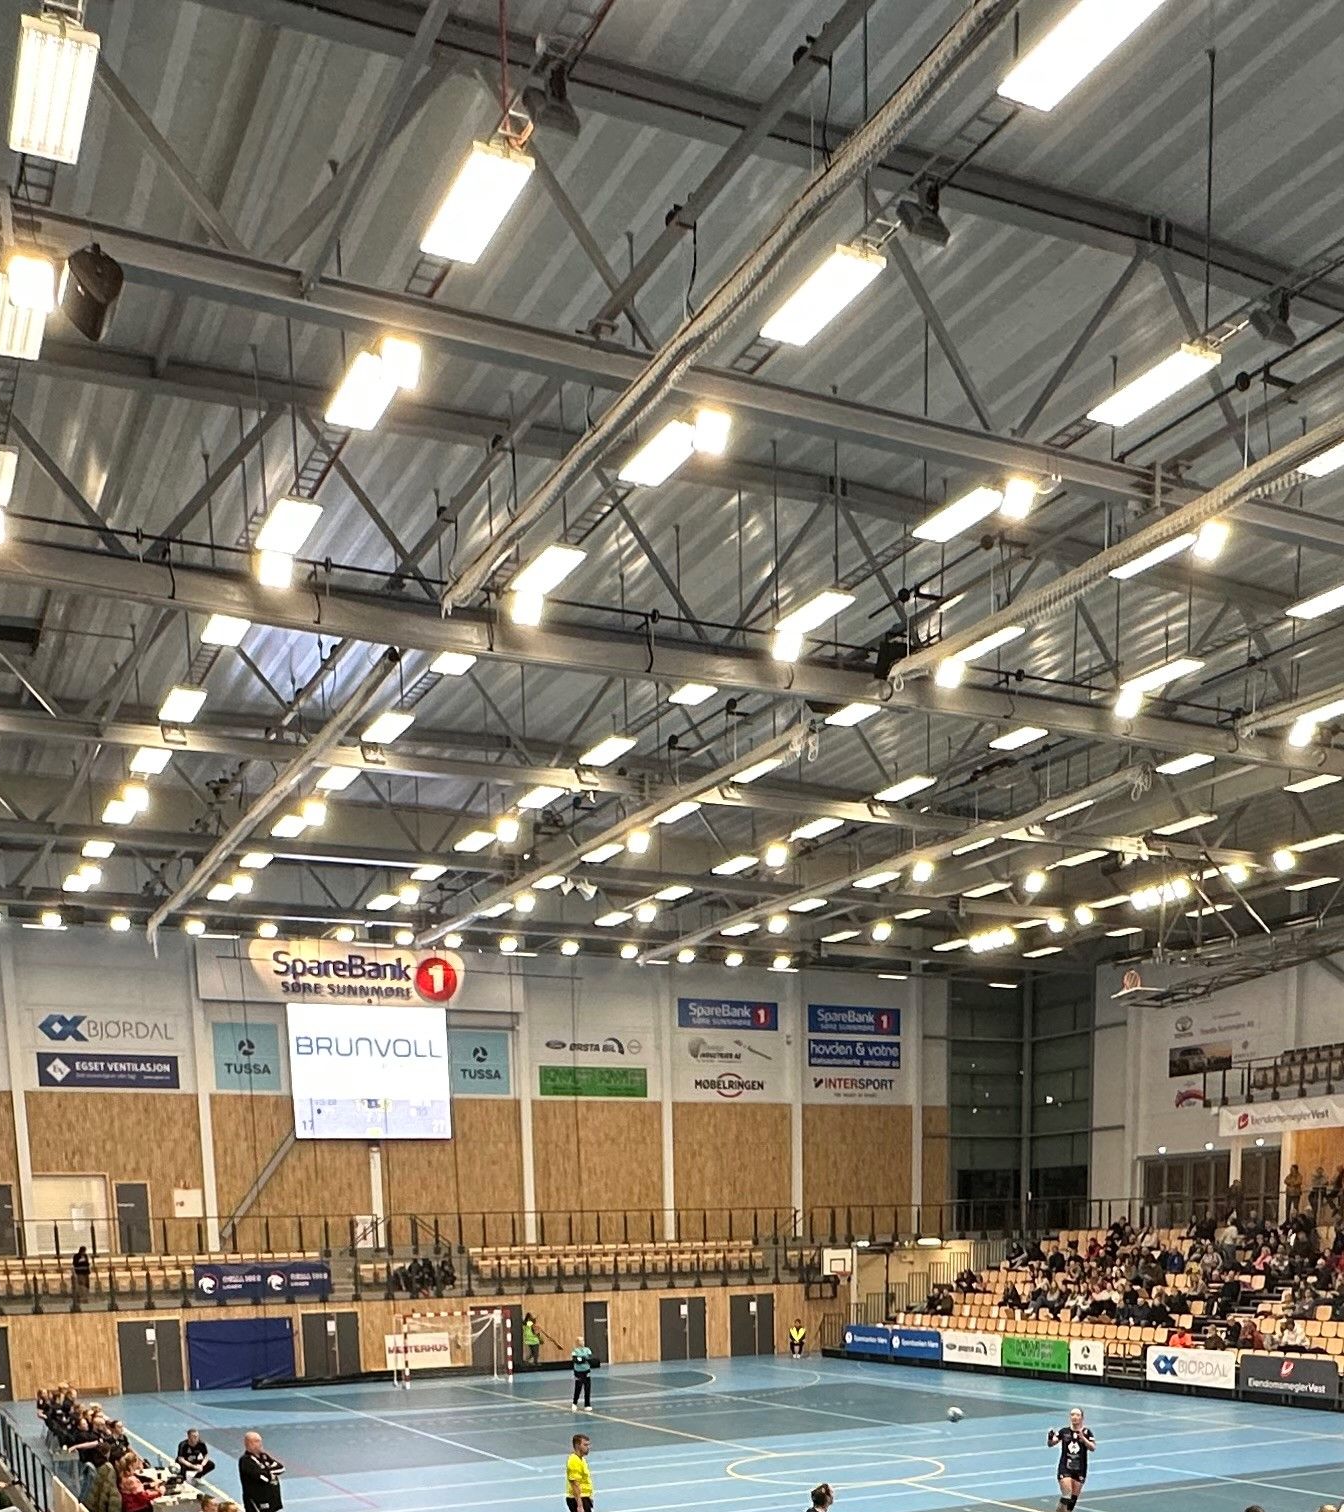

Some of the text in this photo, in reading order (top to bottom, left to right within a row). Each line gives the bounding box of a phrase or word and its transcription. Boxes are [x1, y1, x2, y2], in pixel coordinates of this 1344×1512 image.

[272, 950, 444, 993] SpareBank 1
[281, 980, 413, 998] SØRE SUNNMØRE
[688, 1003, 751, 1018] SpareBank
[817, 1008, 874, 1023] SpareBank
[87, 1019, 174, 1041] BJØRDAL
[295, 1036, 443, 1058] BRUNVOLL
[811, 1040, 853, 1055] hovden
[856, 1042, 865, 1056] &
[75, 1061, 171, 1073] EGSET VENTILASJON
[224, 1062, 271, 1075] TUSSA
[460, 1068, 502, 1080] TUSSA
[695, 1079, 764, 1090] MØBELRINGEN
[825, 1078, 894, 1090] INTERSPORT
[1074, 1363, 1097, 1371] TUSSA
[1247, 1377, 1326, 1394] EiendomsmeglerVest
